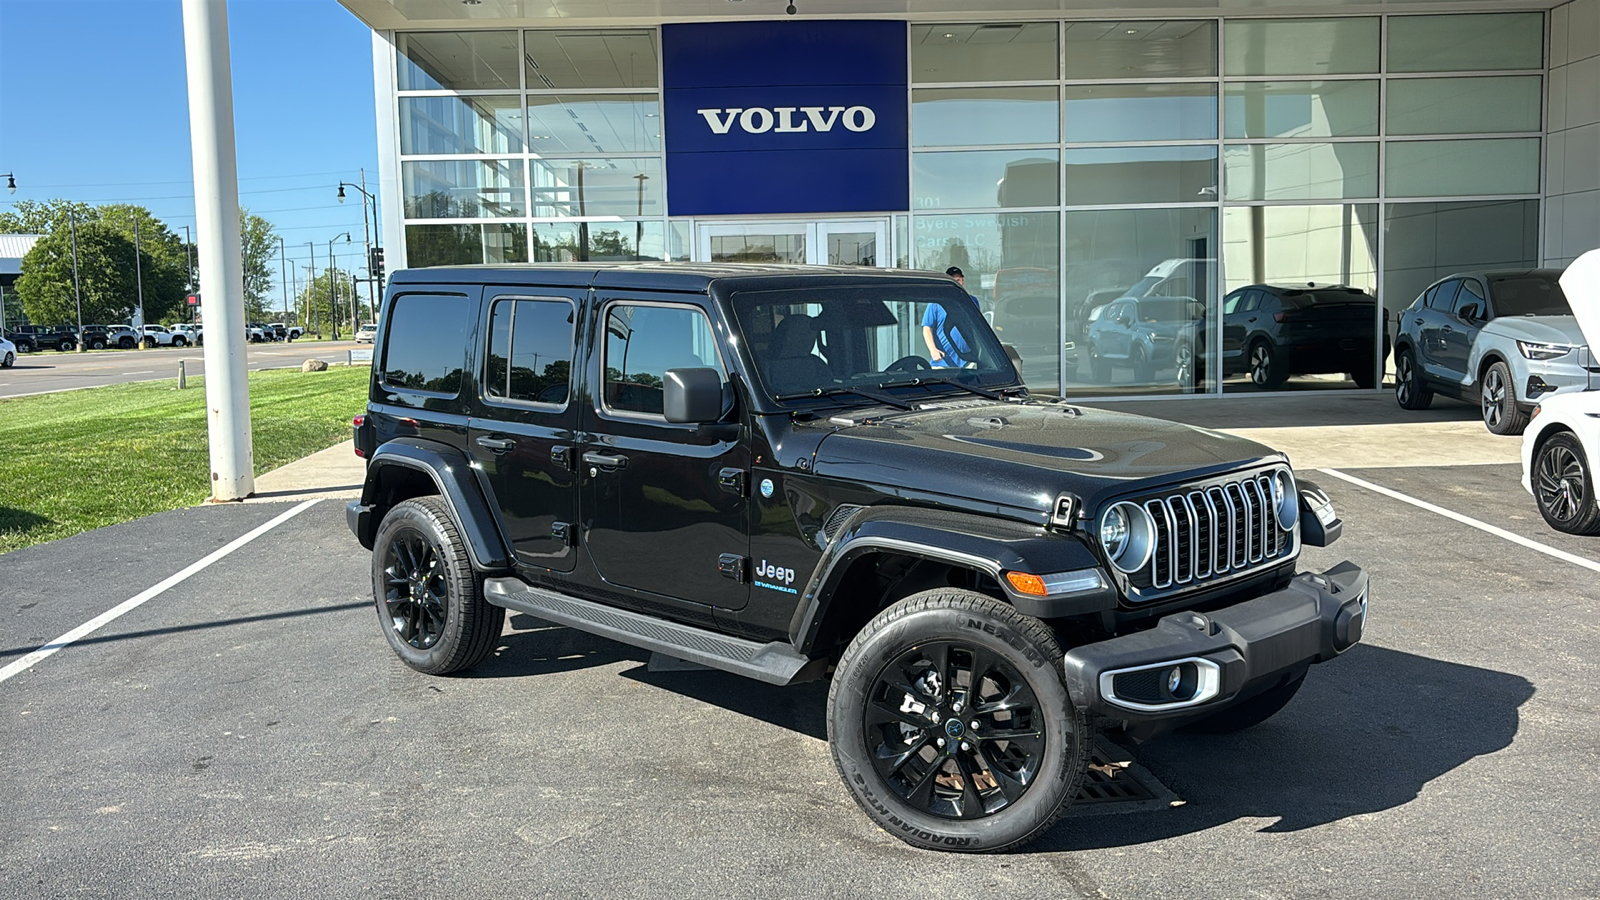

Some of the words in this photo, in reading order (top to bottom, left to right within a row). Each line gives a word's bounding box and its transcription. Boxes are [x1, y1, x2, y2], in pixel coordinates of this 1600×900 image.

[697, 105, 876, 134] VOLVO
[915, 217, 959, 234] Byers
[964, 215, 1029, 228] Swedish
[916, 234, 950, 248] Cars
[956, 232, 986, 247] LLC
[755, 559, 795, 585] Jeep
[761, 581, 798, 595] WRANGLER
[967, 618, 1042, 664] NEXEN
[888, 816, 971, 847] ROADIAN
